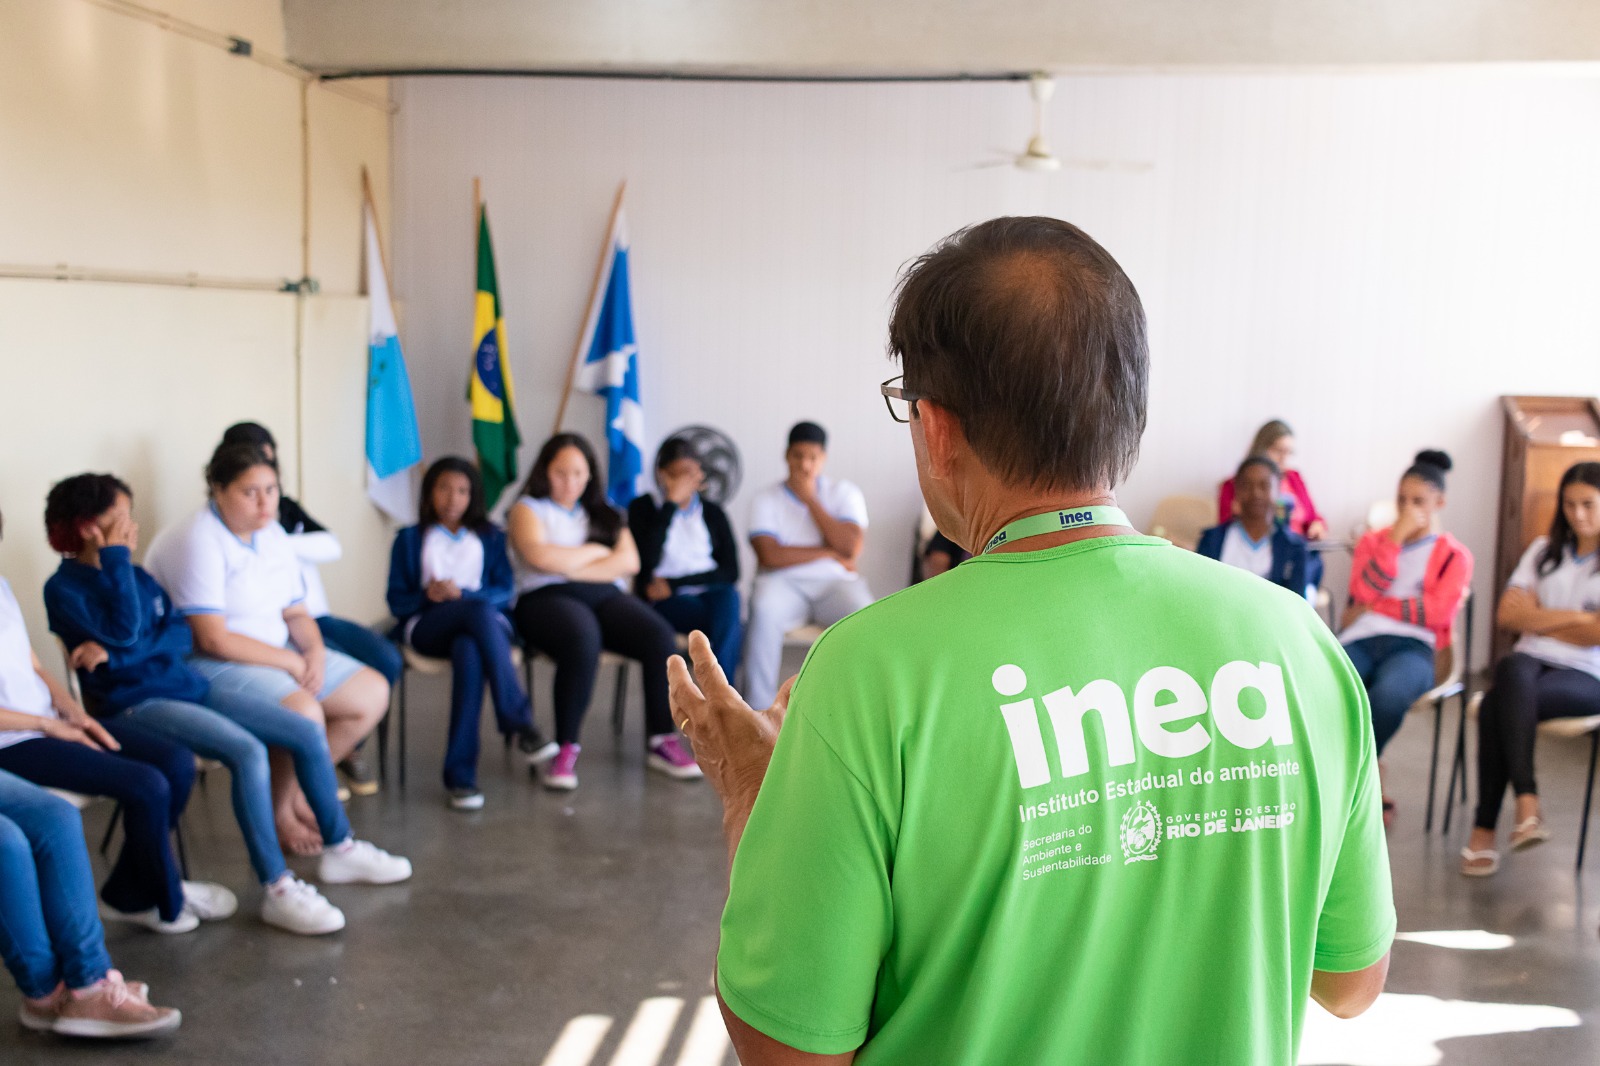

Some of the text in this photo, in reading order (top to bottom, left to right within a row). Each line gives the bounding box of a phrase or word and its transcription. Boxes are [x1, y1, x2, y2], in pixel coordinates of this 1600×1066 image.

[1059, 511, 1093, 525] inea
[992, 660, 1294, 789] inea
[1019, 759, 1300, 823] Instituto Estadual do ambiente
[1166, 809, 1227, 824] GOVERNO
[1234, 808, 1253, 816] DO
[1023, 824, 1092, 851] Secretaria do
[1166, 823, 1201, 840] RIO
[1204, 818, 1227, 836] DE
[1022, 843, 1082, 867] Ambiente e
[1022, 853, 1112, 880] Sustentabilidade
